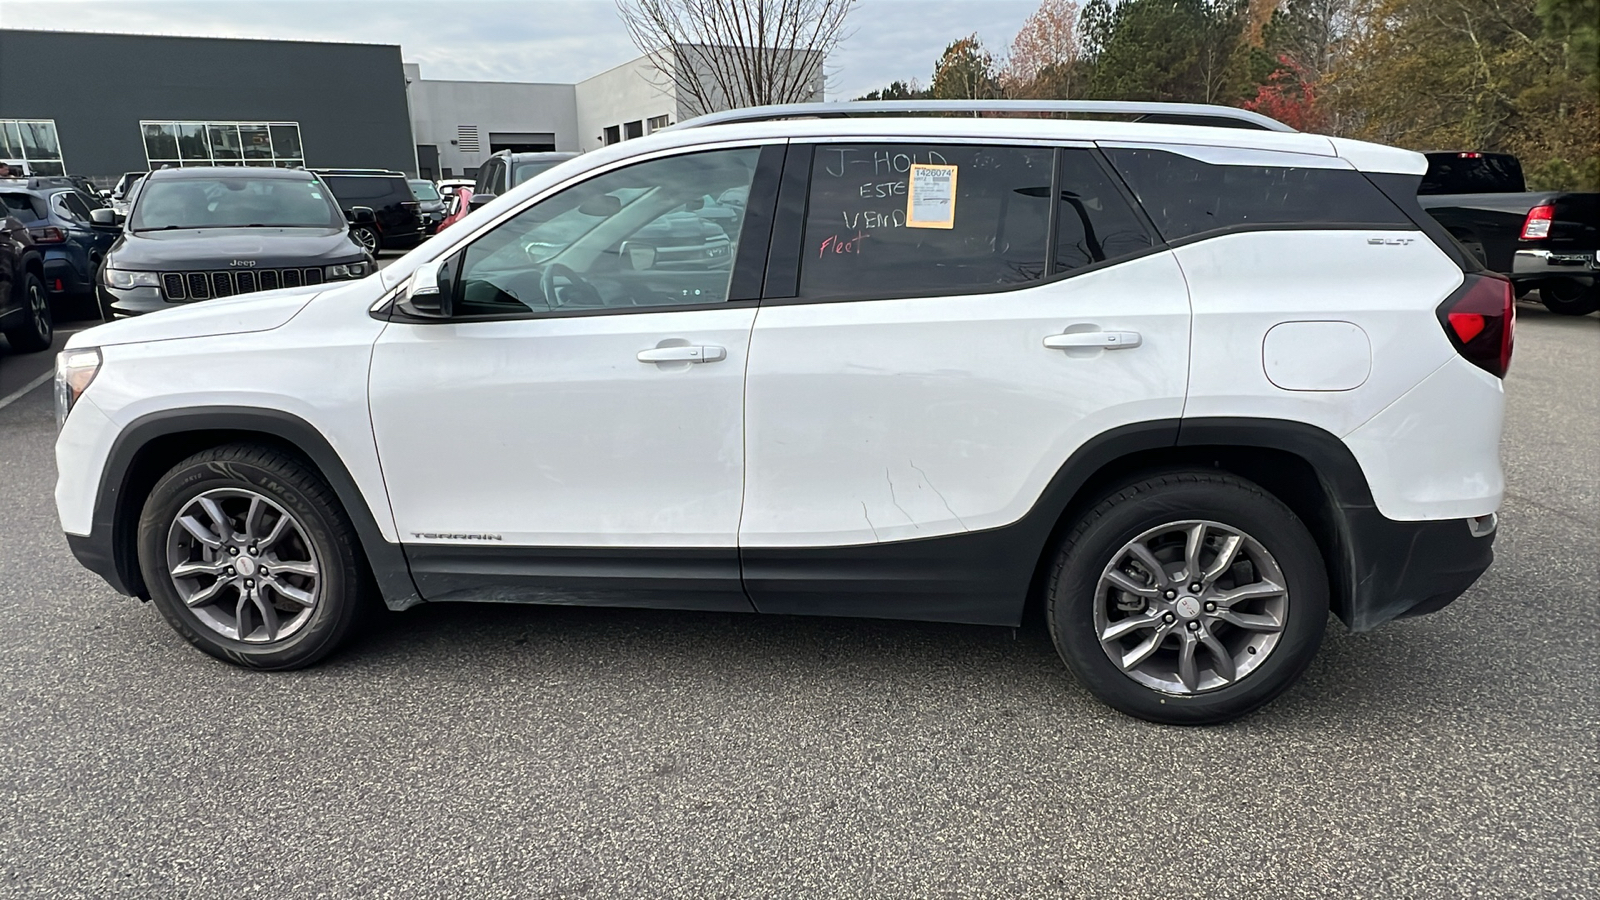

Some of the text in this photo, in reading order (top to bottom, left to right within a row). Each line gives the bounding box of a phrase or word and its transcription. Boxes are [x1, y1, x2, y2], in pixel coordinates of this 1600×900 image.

[915, 169, 952, 177] 1426074
[819, 229, 871, 259] Fleet
[1366, 238, 1415, 246] SLT
[229, 259, 257, 268] Jeep
[410, 532, 503, 541] TERRAIN
